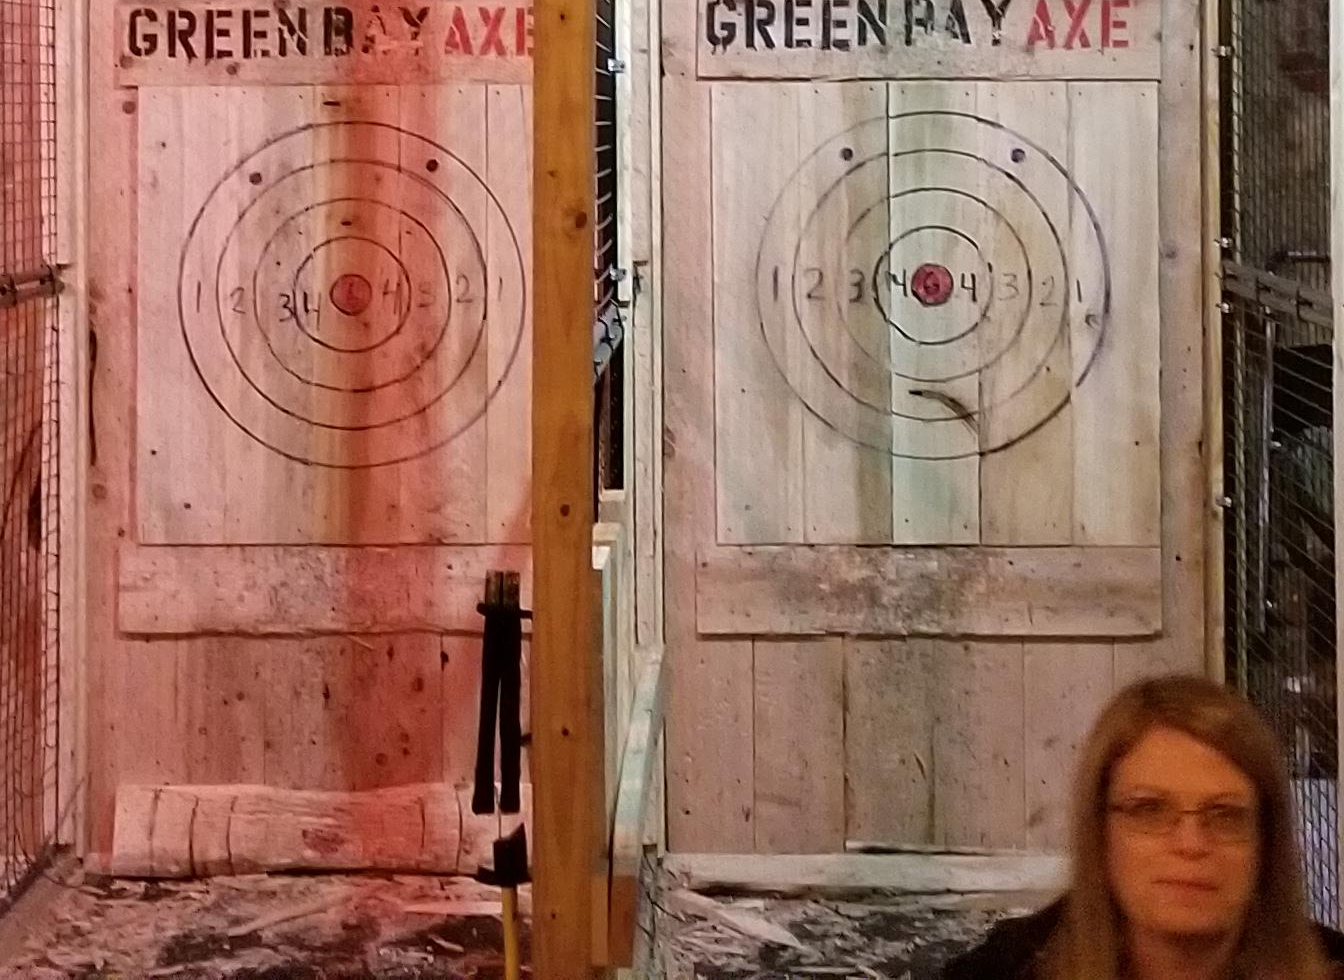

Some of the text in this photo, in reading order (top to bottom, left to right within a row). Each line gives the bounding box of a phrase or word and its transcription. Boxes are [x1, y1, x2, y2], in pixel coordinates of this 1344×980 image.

[127, 5, 308, 60] GREEN
[323, 4, 430, 58] BAY
[230, 287, 246, 314] 2
[278, 292, 296, 322] 3
[303, 290, 321, 331] 4
[455, 274, 474, 304] 2
[805, 268, 825, 300] 2
[849, 270, 865, 303] 3
[960, 272, 977, 302] 4
[998, 273, 1018, 301] 3
